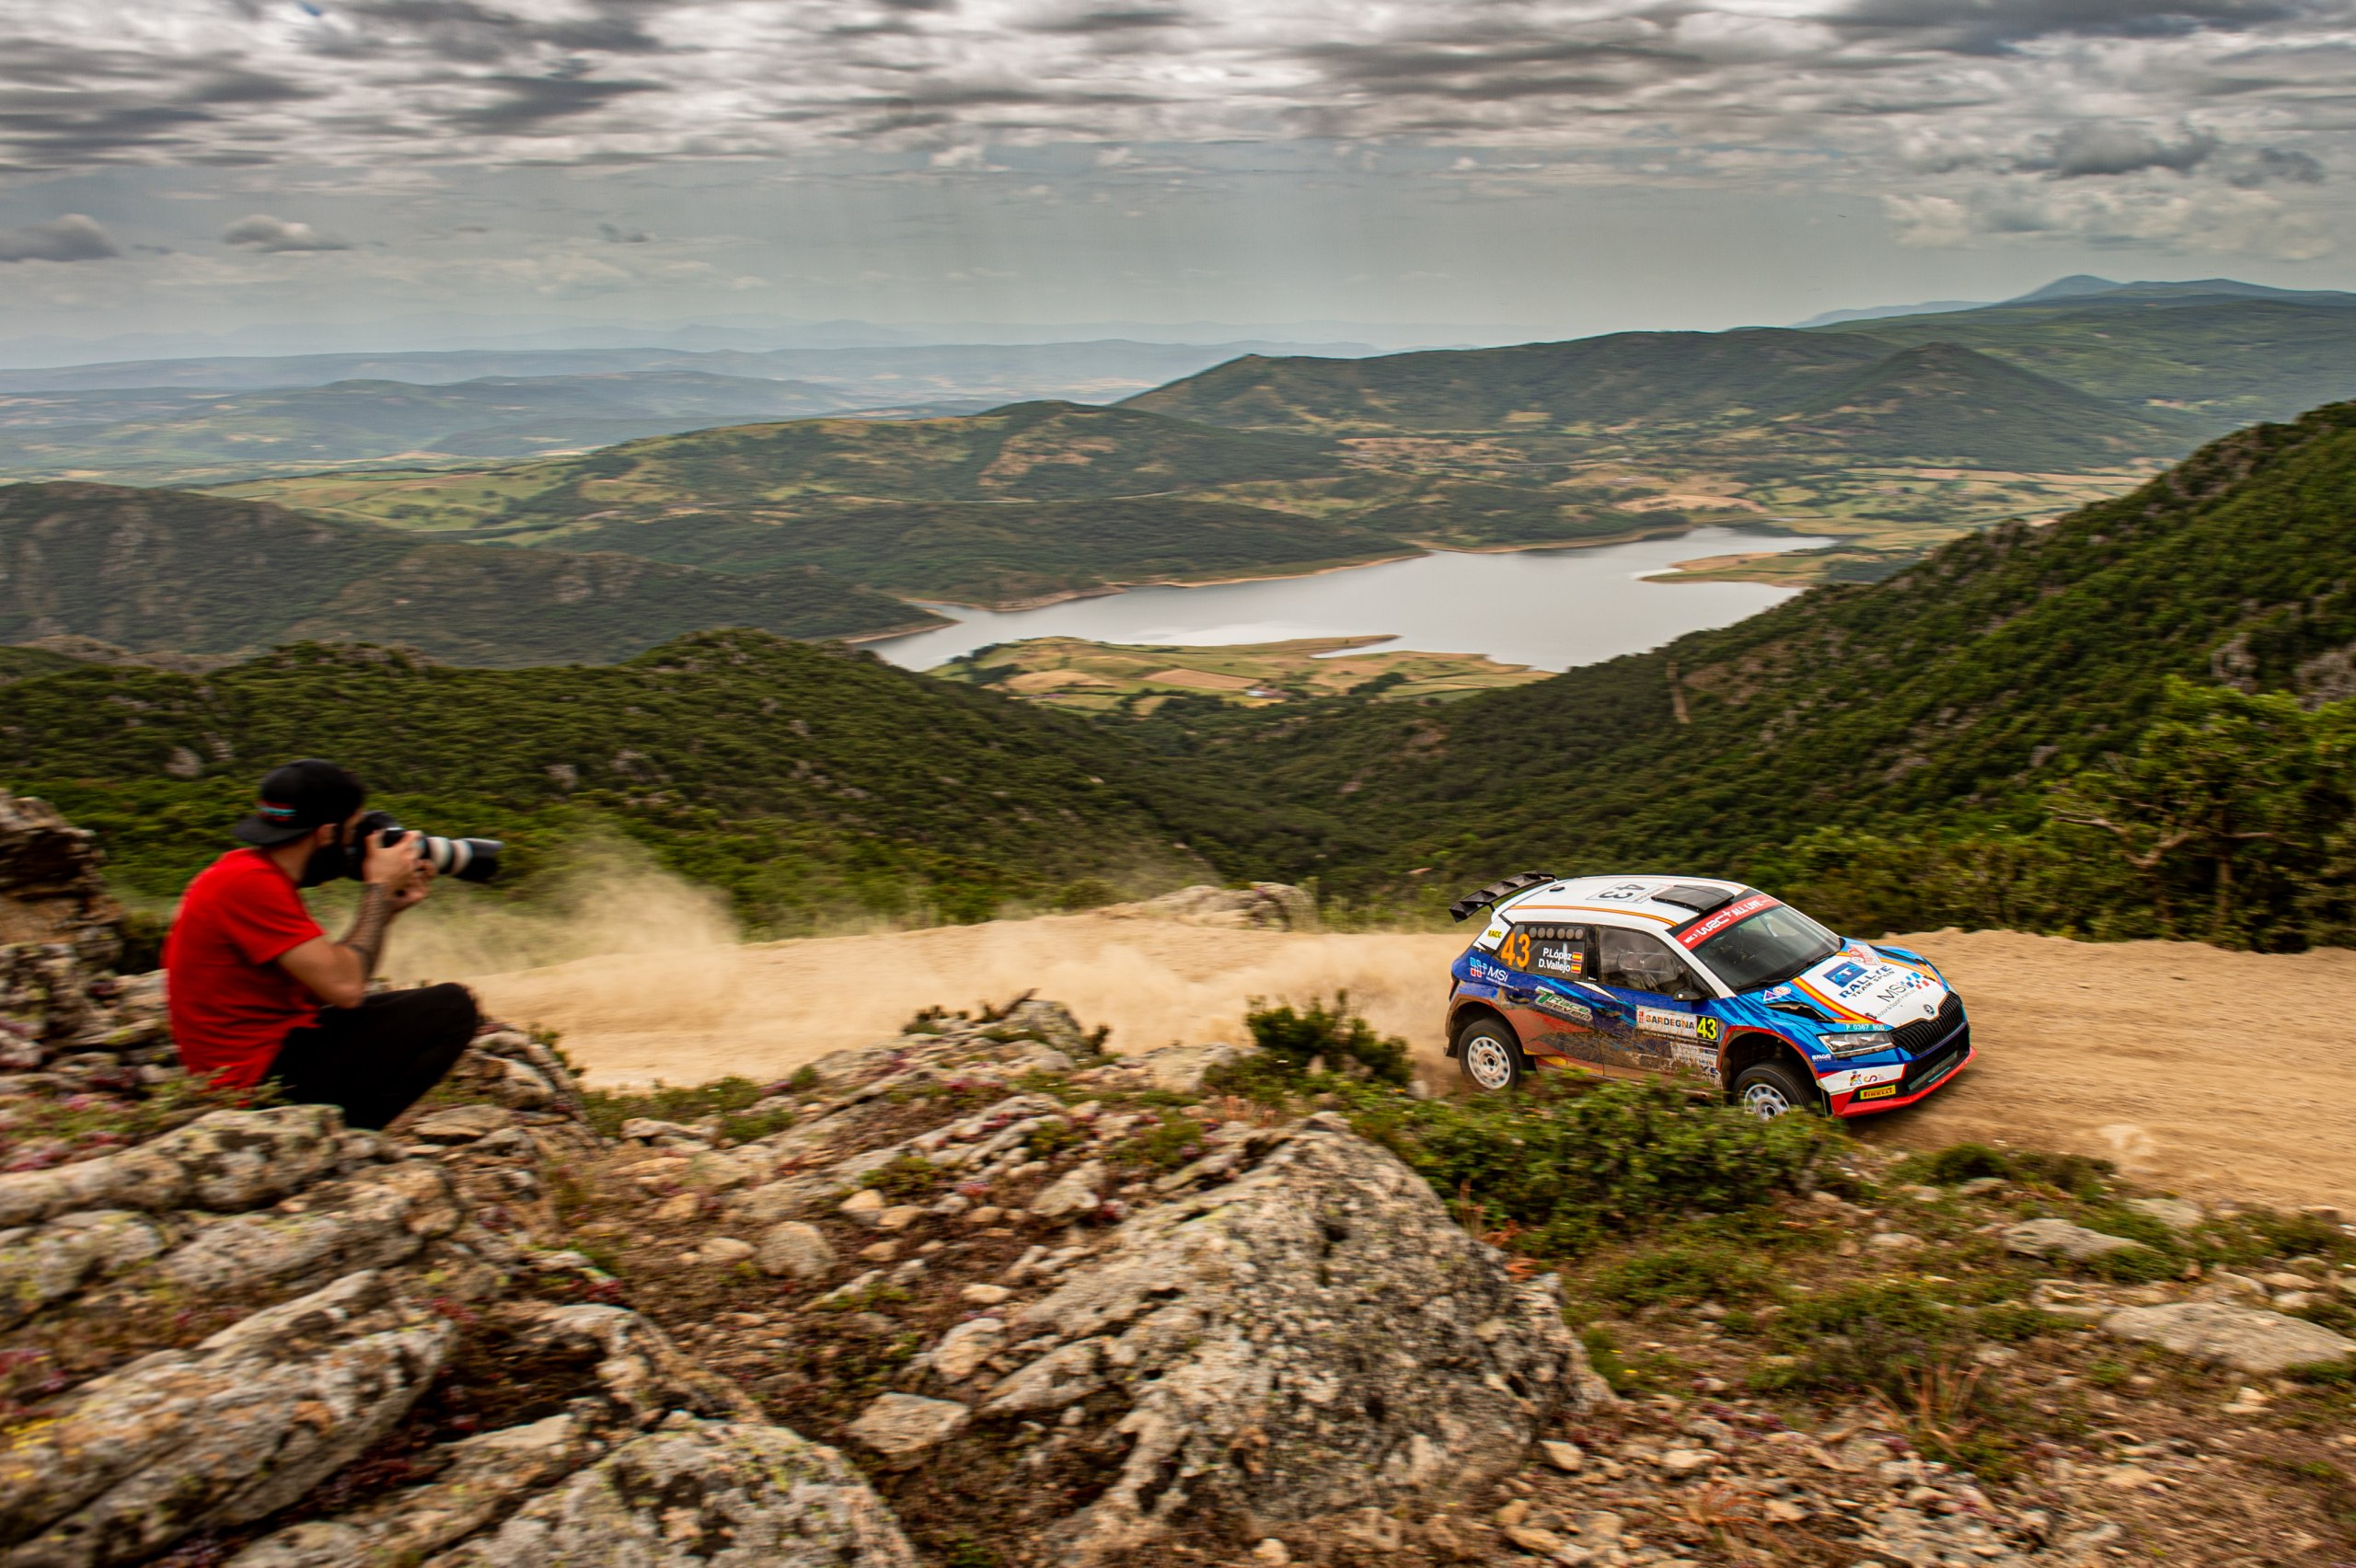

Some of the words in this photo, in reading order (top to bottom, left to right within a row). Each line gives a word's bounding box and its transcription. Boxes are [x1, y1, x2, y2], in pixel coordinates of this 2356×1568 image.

[1599, 884, 1646, 899] 43
[1487, 929, 1502, 939] RACC
[1501, 932, 1530, 968] 43
[1542, 947, 1572, 961] P.López
[1538, 958, 1571, 974] D.Vallejo
[1839, 965, 1891, 998] RALLYE
[1852, 982, 1873, 997] TEAM
[1646, 1014, 1695, 1030] SARDEGNA
[1697, 1017, 1717, 1040] 43
